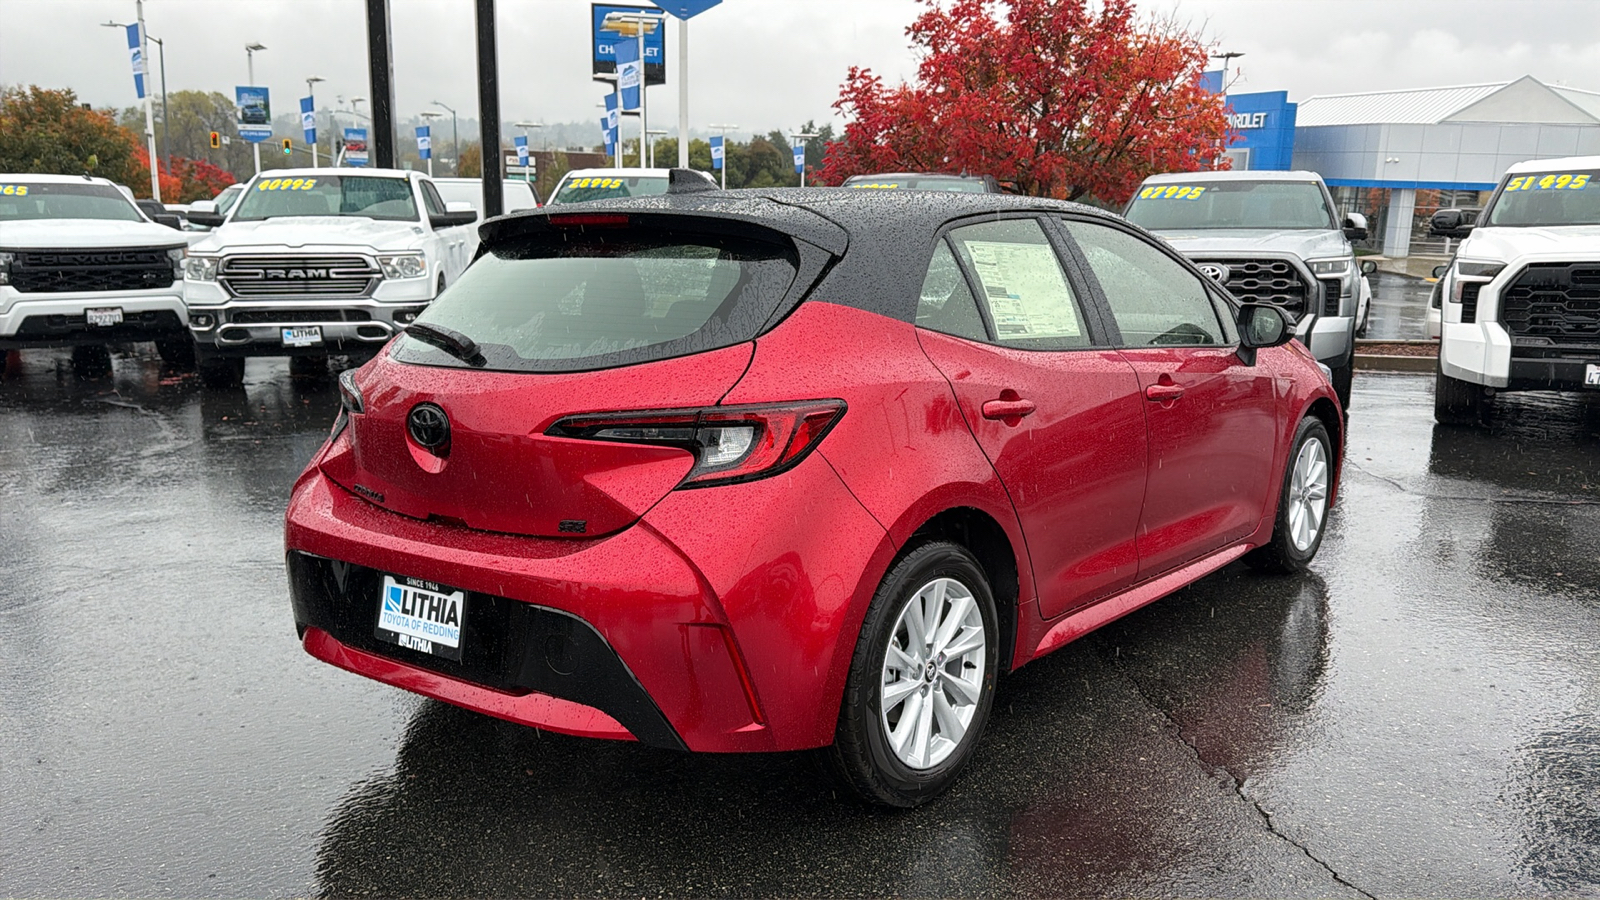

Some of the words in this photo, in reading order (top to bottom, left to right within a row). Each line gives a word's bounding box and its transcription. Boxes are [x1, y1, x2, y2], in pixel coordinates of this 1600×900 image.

[258, 178, 317, 191] 40995
[568, 177, 623, 189] 28995
[0, 184, 28, 196] 65
[1139, 185, 1206, 199] 47995
[265, 268, 327, 279] RAM
[292, 327, 319, 339] LITHIA
[406, 577, 424, 588] SINCE
[425, 581, 439, 592] 1946
[401, 589, 459, 628] LITHIA
[383, 611, 410, 629] TOYOTA
[411, 619, 422, 631] OF
[422, 622, 459, 640] REDDING
[406, 635, 433, 654] LITHIA
